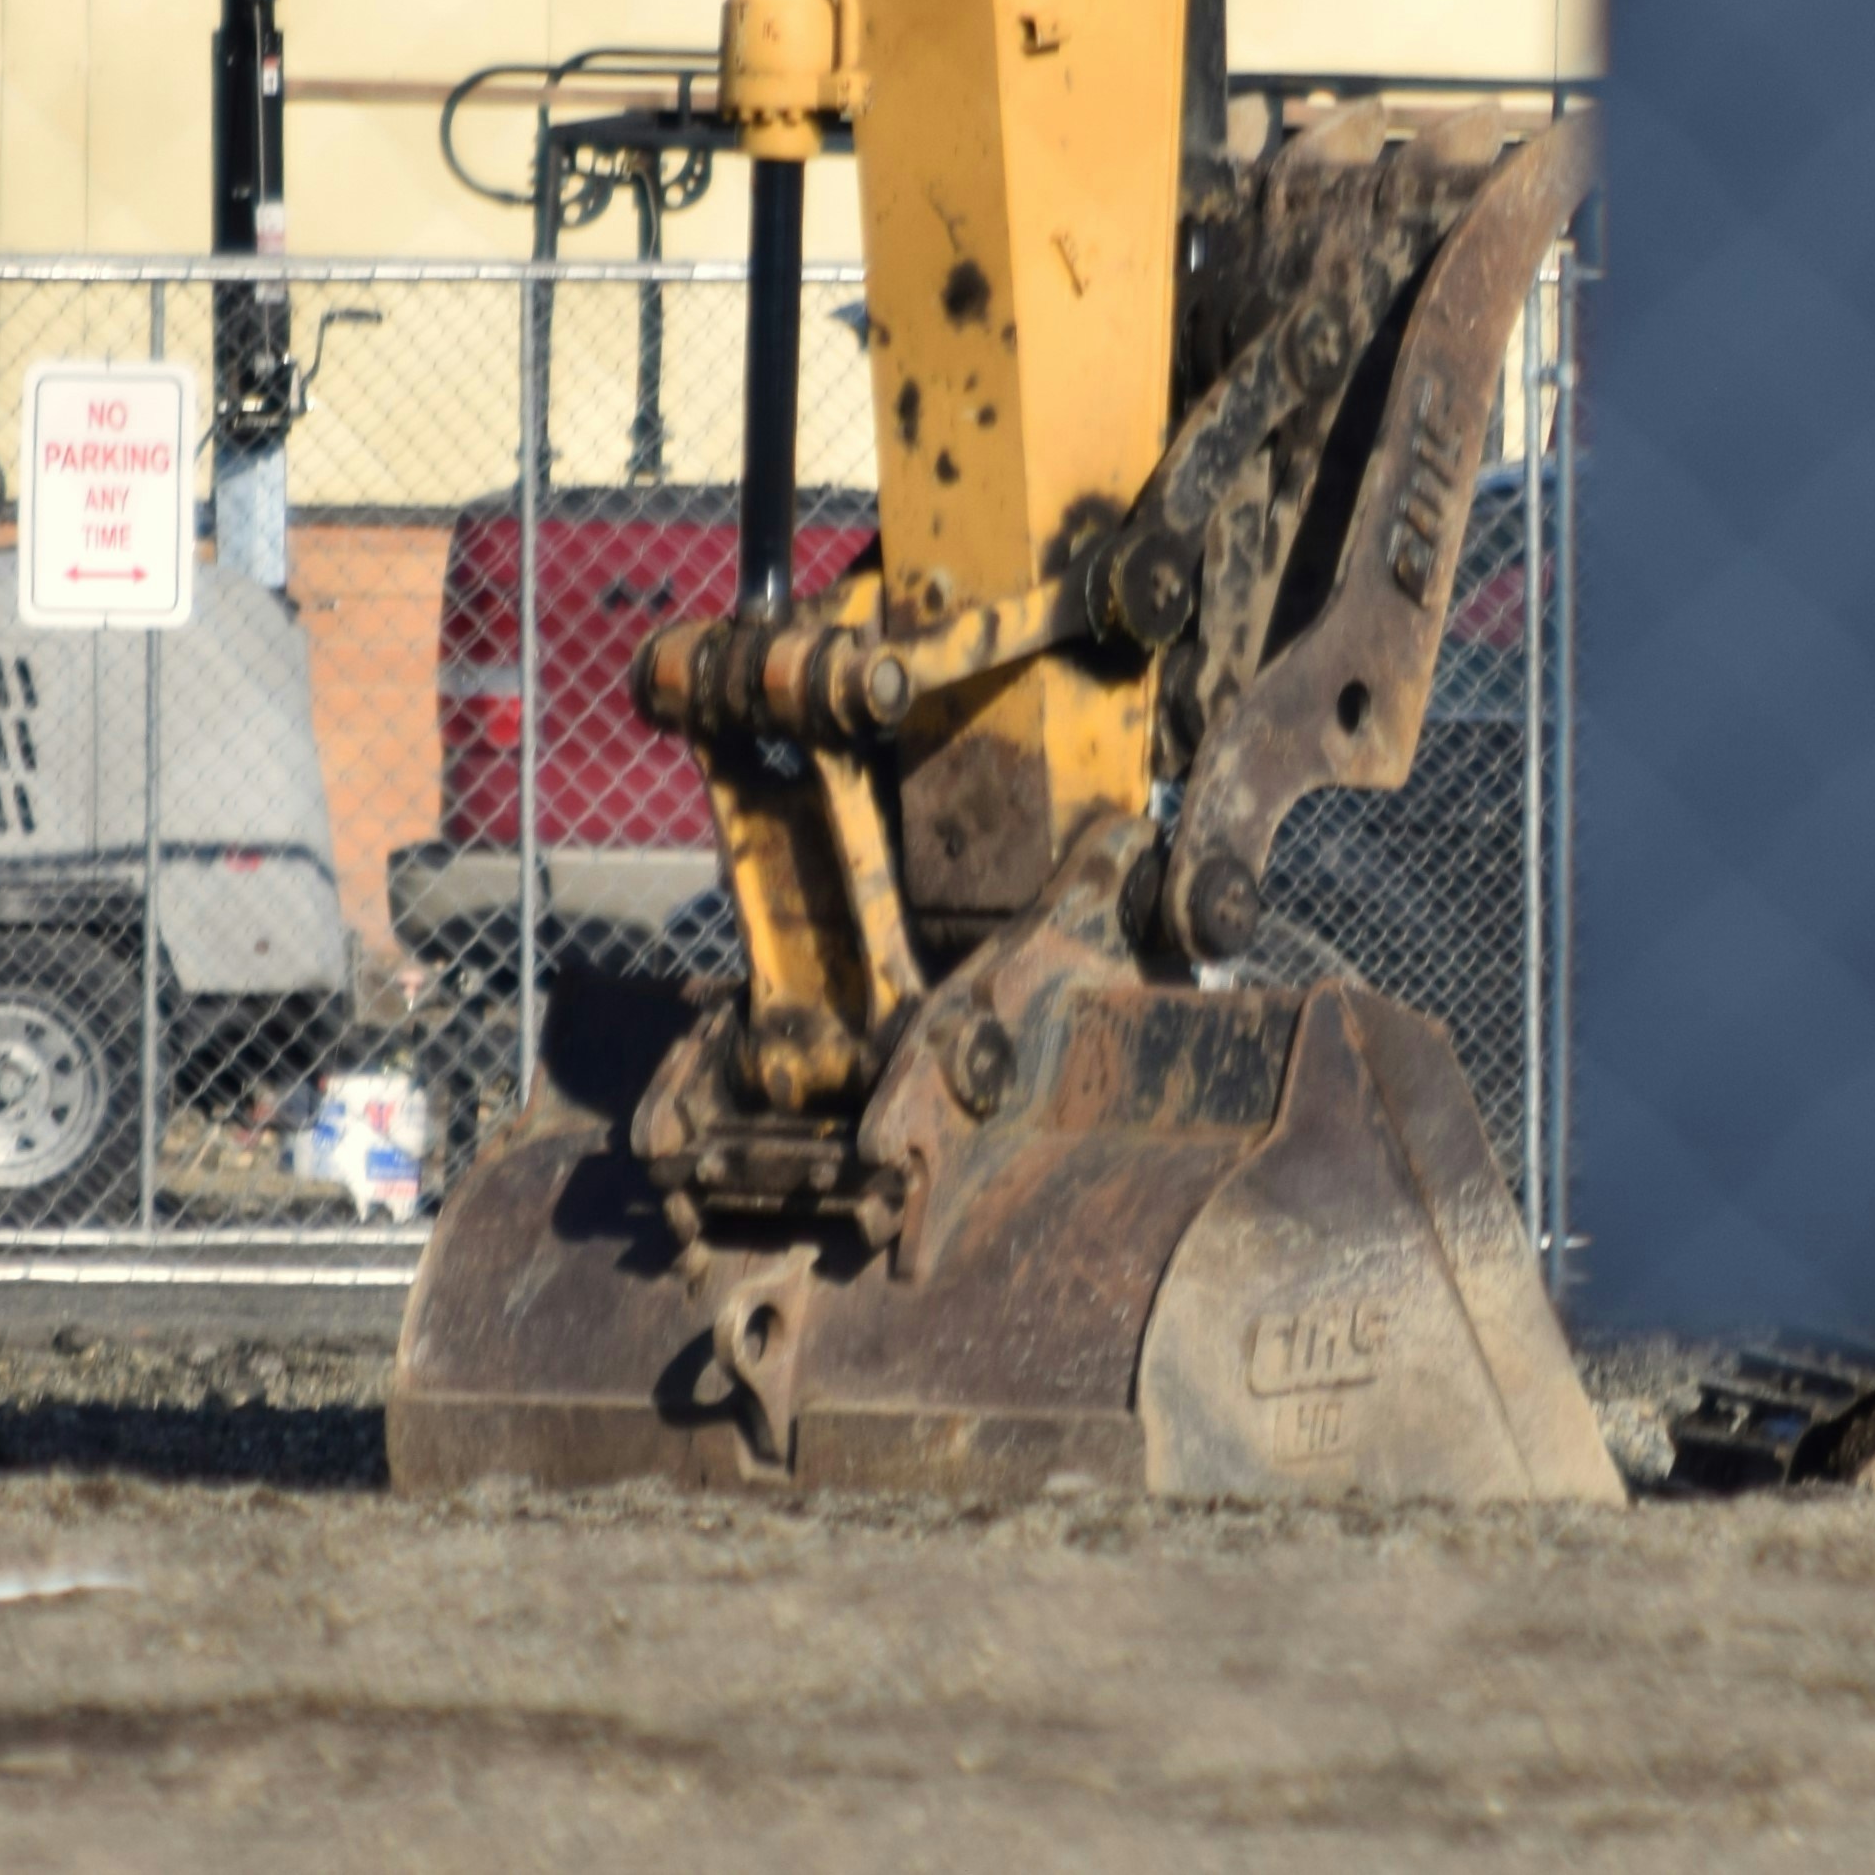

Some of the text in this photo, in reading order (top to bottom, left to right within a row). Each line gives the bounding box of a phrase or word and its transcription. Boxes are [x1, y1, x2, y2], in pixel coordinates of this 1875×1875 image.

[87, 401, 128, 431] NO
[44, 442, 170, 474] PARKING
[85, 487, 130, 514] ANY
[84, 524, 131, 551] TIME
